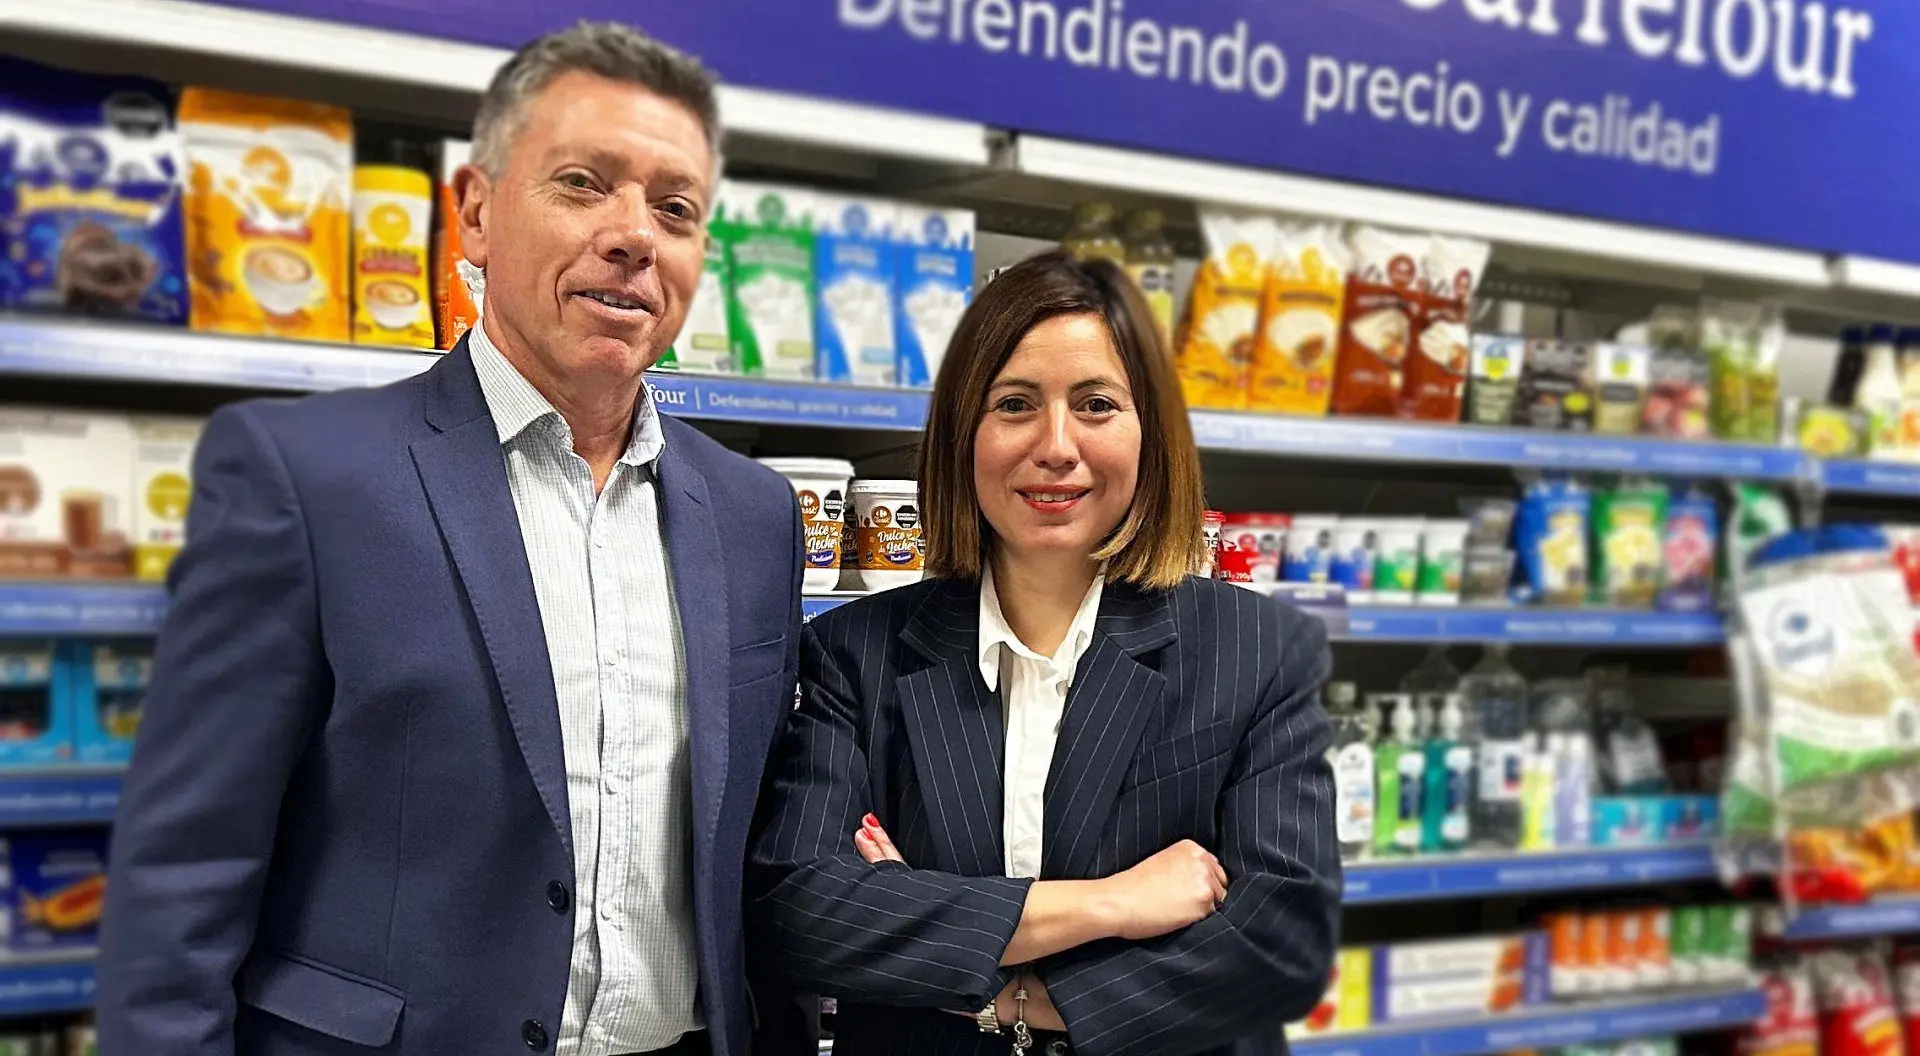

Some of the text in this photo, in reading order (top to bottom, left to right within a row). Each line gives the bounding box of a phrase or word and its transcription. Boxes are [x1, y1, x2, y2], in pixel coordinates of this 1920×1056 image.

[1304, 54, 1484, 132] precio
[1496, 91, 1531, 157] y
[1542, 92, 1720, 175] calidad
[877, 529, 906, 543] Dulce
